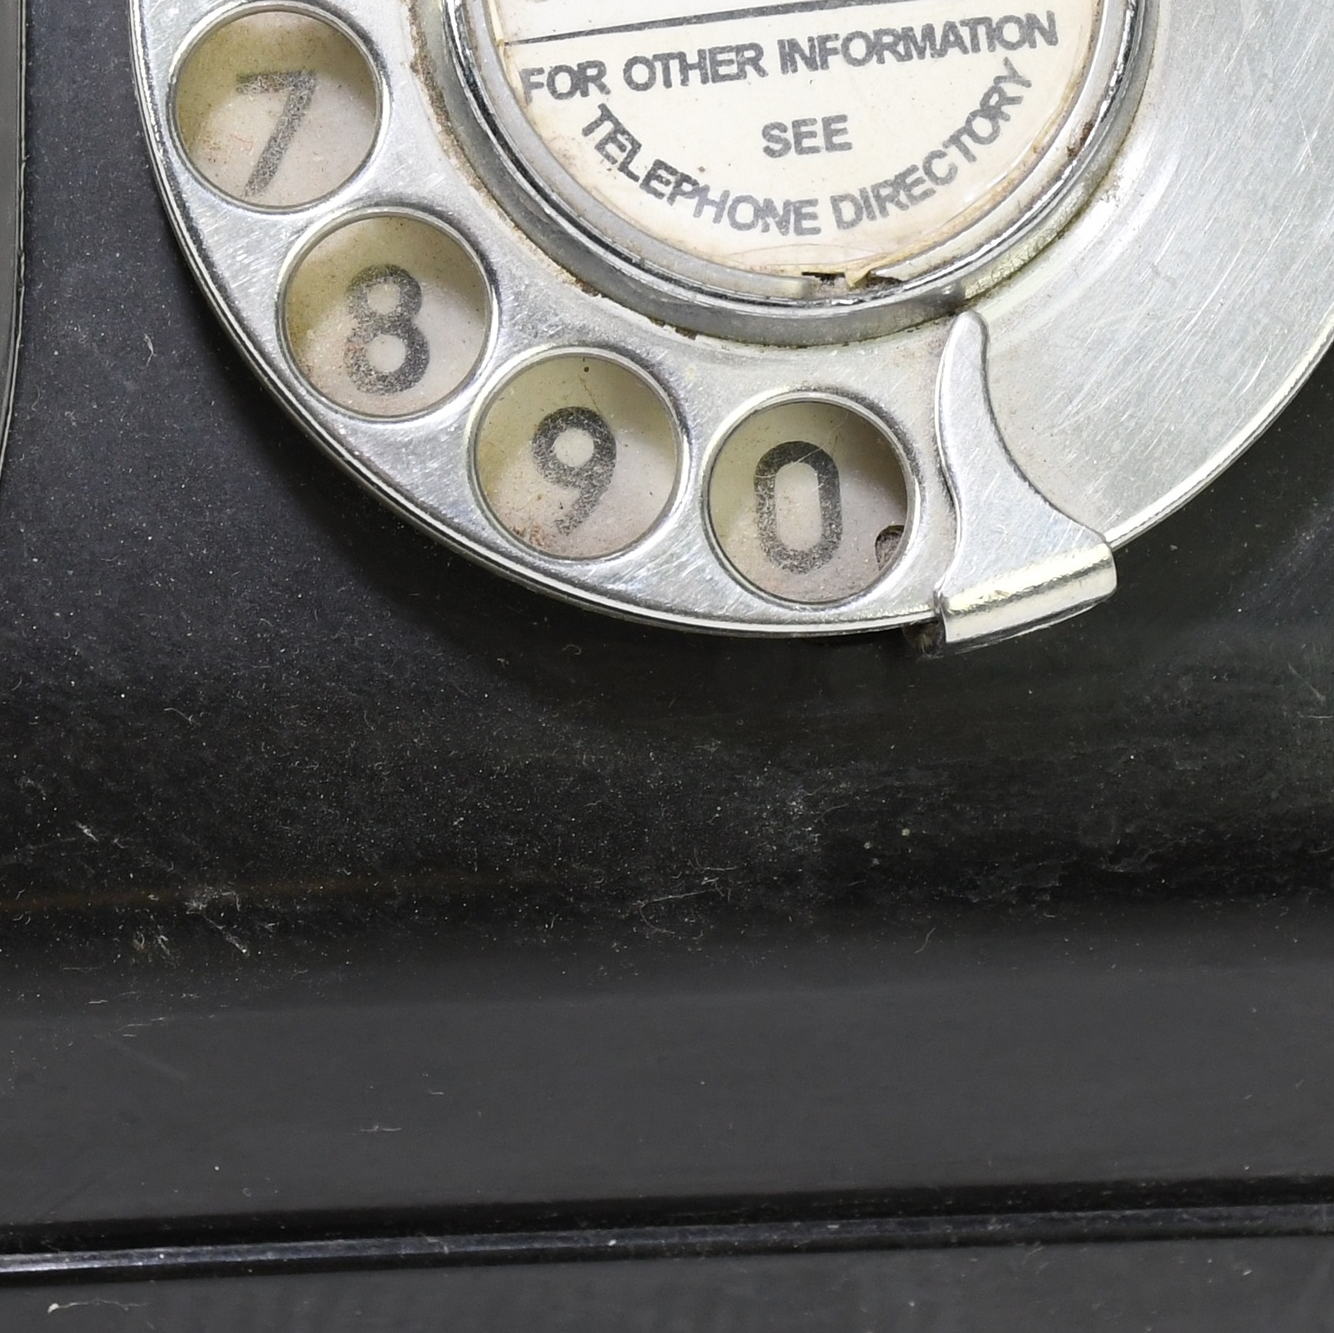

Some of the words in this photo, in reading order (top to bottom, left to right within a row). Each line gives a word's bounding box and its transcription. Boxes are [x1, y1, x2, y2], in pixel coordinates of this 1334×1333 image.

[518, 61, 611, 103] FOR
[623, 42, 767, 92] OTHER
[779, 10, 1058, 75] INFORMATION
[236, 69, 318, 199] 7
[581, 103, 822, 236] TELEPHONE
[831, 57, 1033, 230] DIRECTORY
[762, 113, 853, 159] SEE
[344, 265, 427, 395] 8
[531, 407, 618, 535] 9
[754, 440, 839, 574] 0
